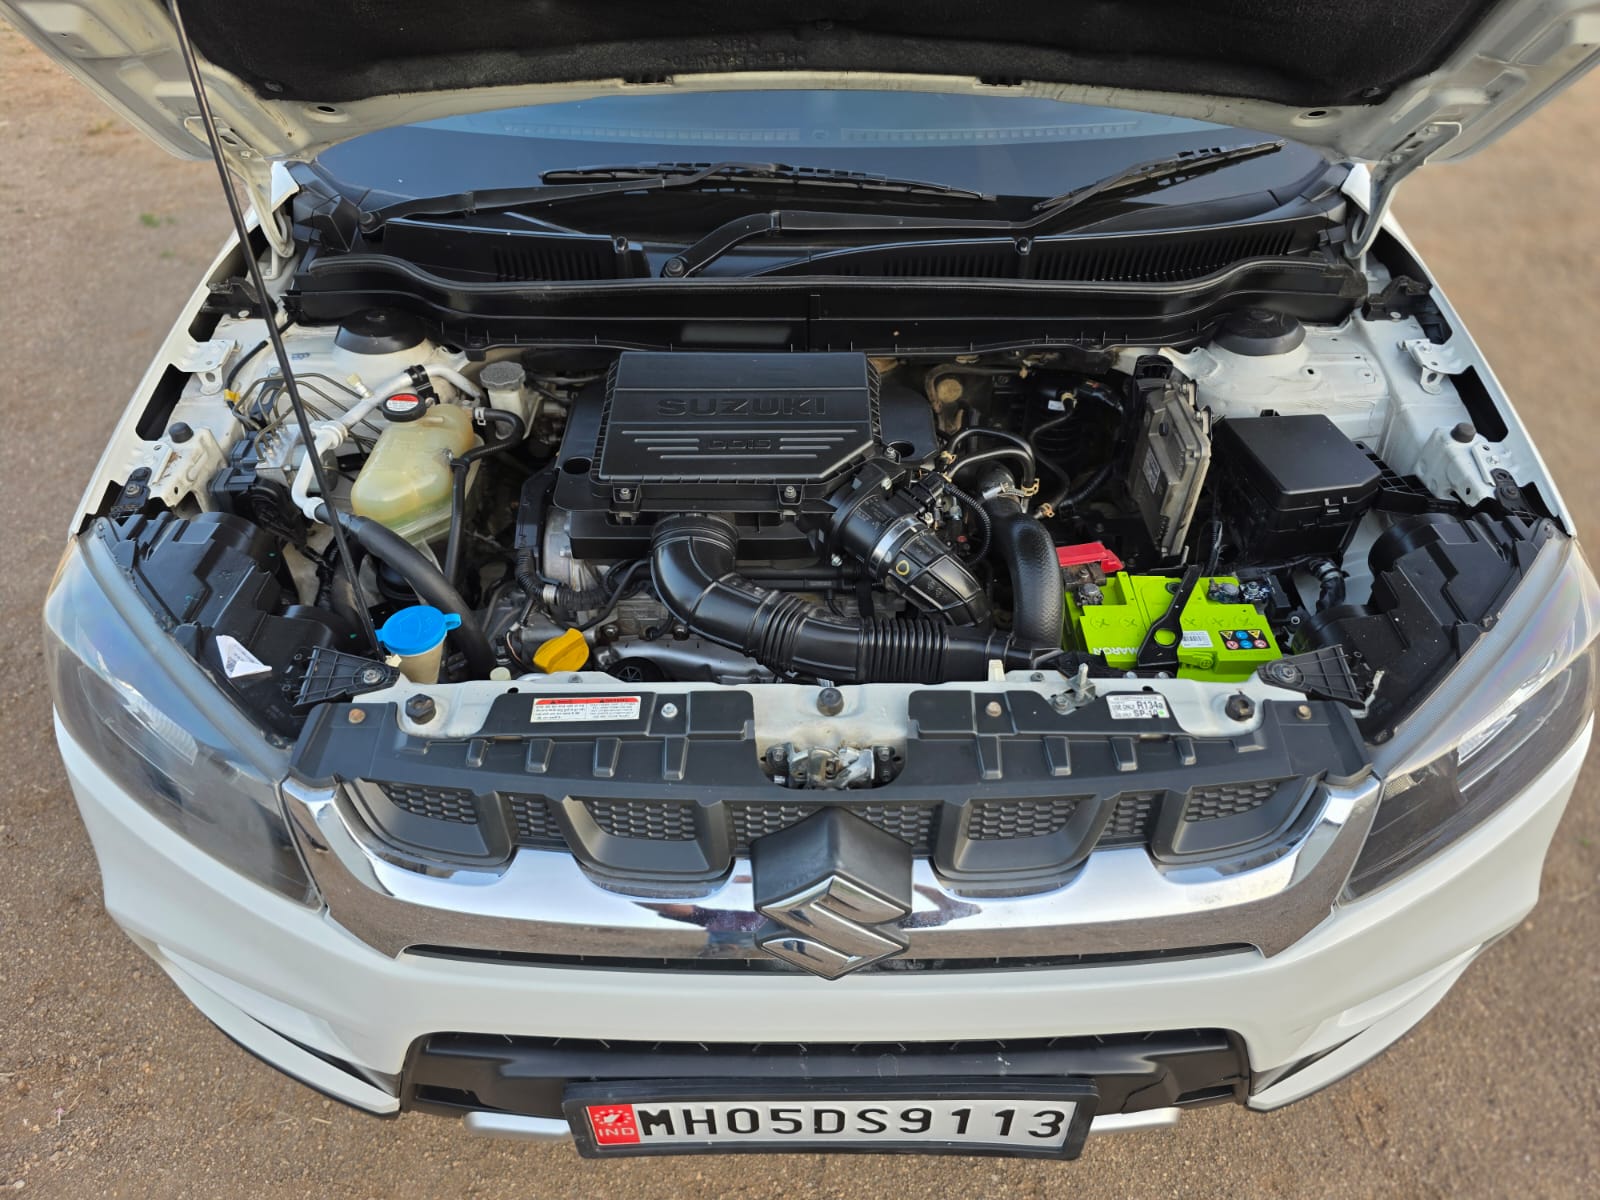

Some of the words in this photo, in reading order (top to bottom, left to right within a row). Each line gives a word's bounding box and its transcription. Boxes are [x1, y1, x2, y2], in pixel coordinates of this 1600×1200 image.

[657, 397, 826, 416] SUZUKI
[1092, 647, 1139, 656] MARON
[637, 1107, 1066, 1138] MH05DS9113
[598, 1127, 635, 1137] IND
